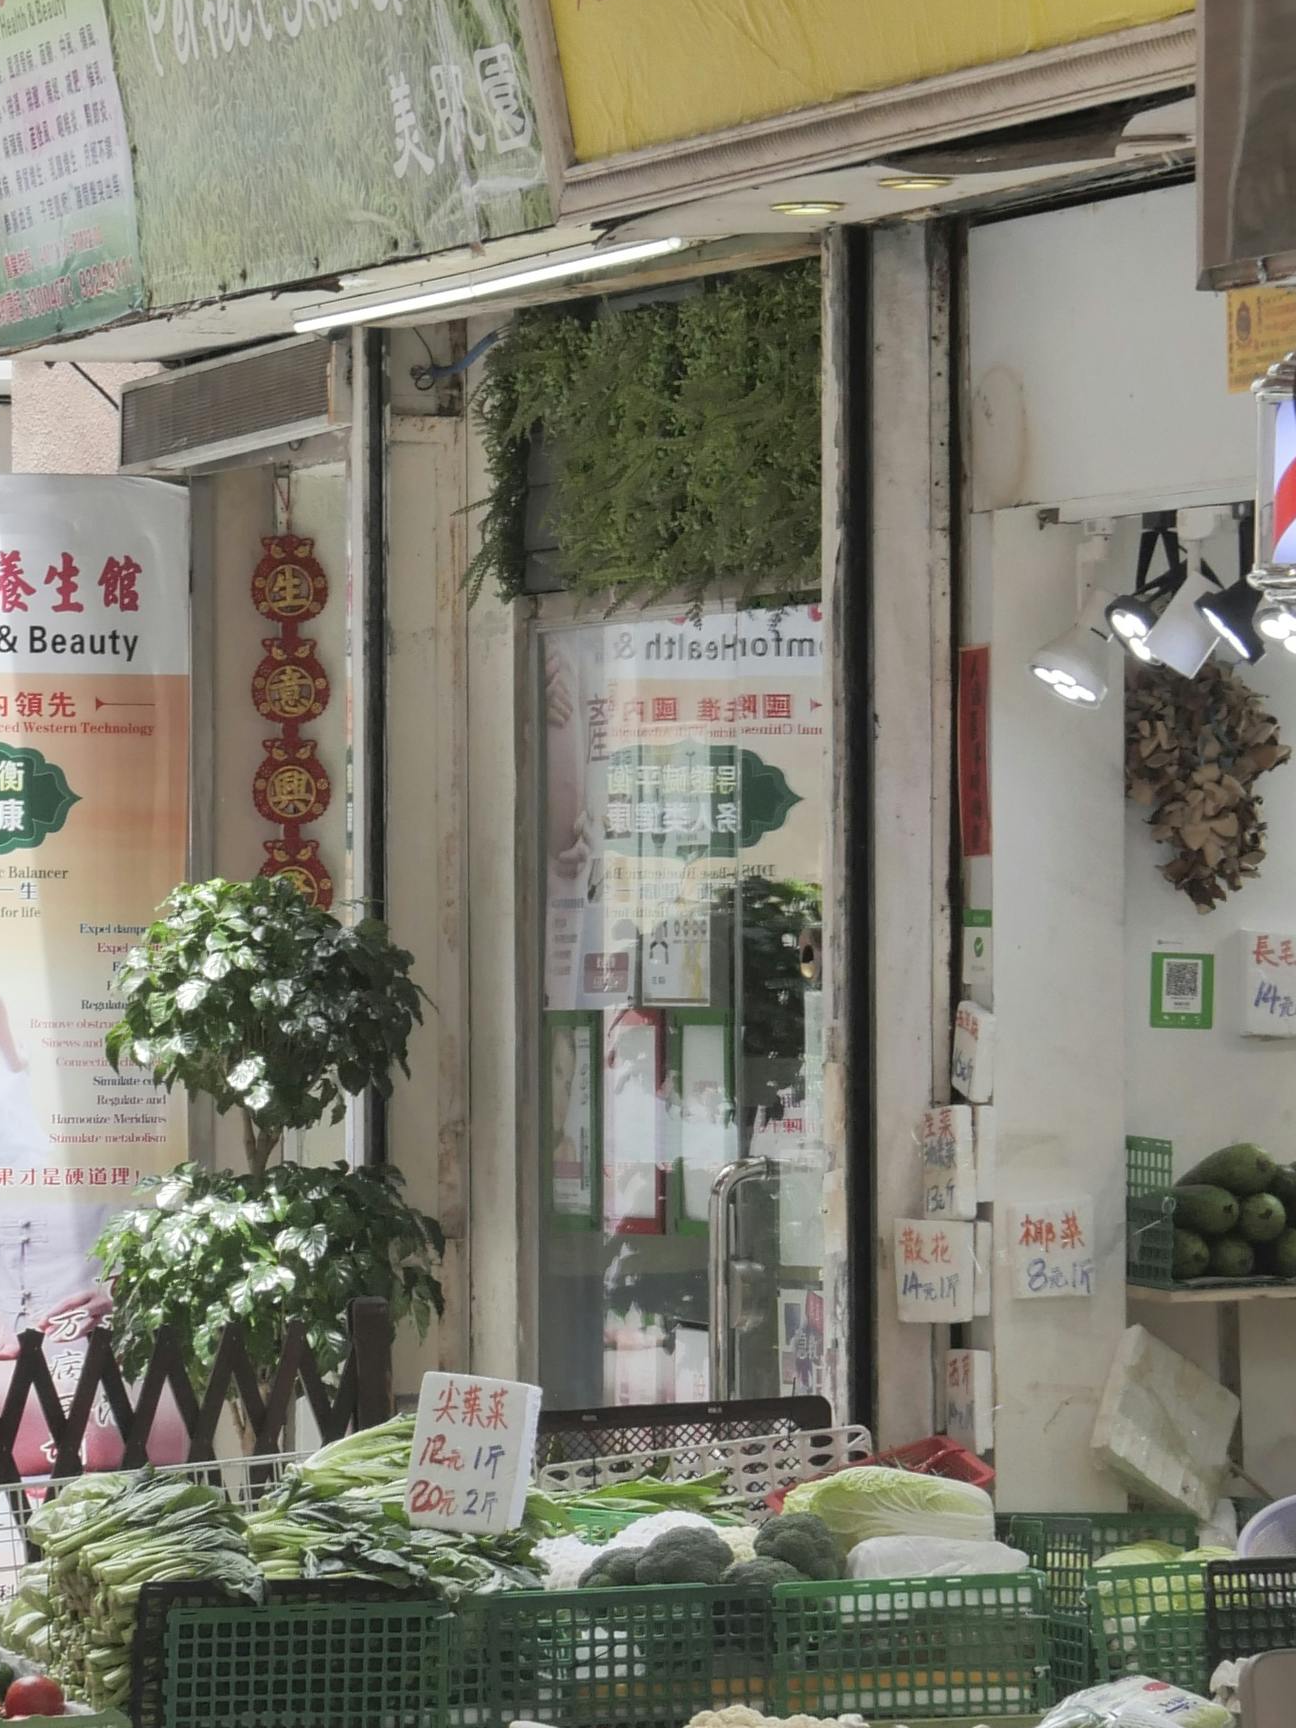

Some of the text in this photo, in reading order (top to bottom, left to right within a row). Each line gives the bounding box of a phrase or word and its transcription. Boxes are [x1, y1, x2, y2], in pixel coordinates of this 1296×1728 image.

[388, 42, 533, 178] 美肌園
[29, 627, 140, 662] Beauty
[23, 721, 78, 735] Western
[80, 722, 155, 737] Technology
[8, 866, 69, 880] Balancer
[3, 907, 18, 919] for
[21, 907, 41, 919] life
[79, 923, 111, 936] Expel
[97, 942, 129, 955] Expel
[83, 1037, 103, 1049] and
[97, 1094, 167, 1106] Regulate and
[51, 1113, 167, 1124] Harmonize Meridians
[49, 1132, 167, 1144] Stimulate metabolism
